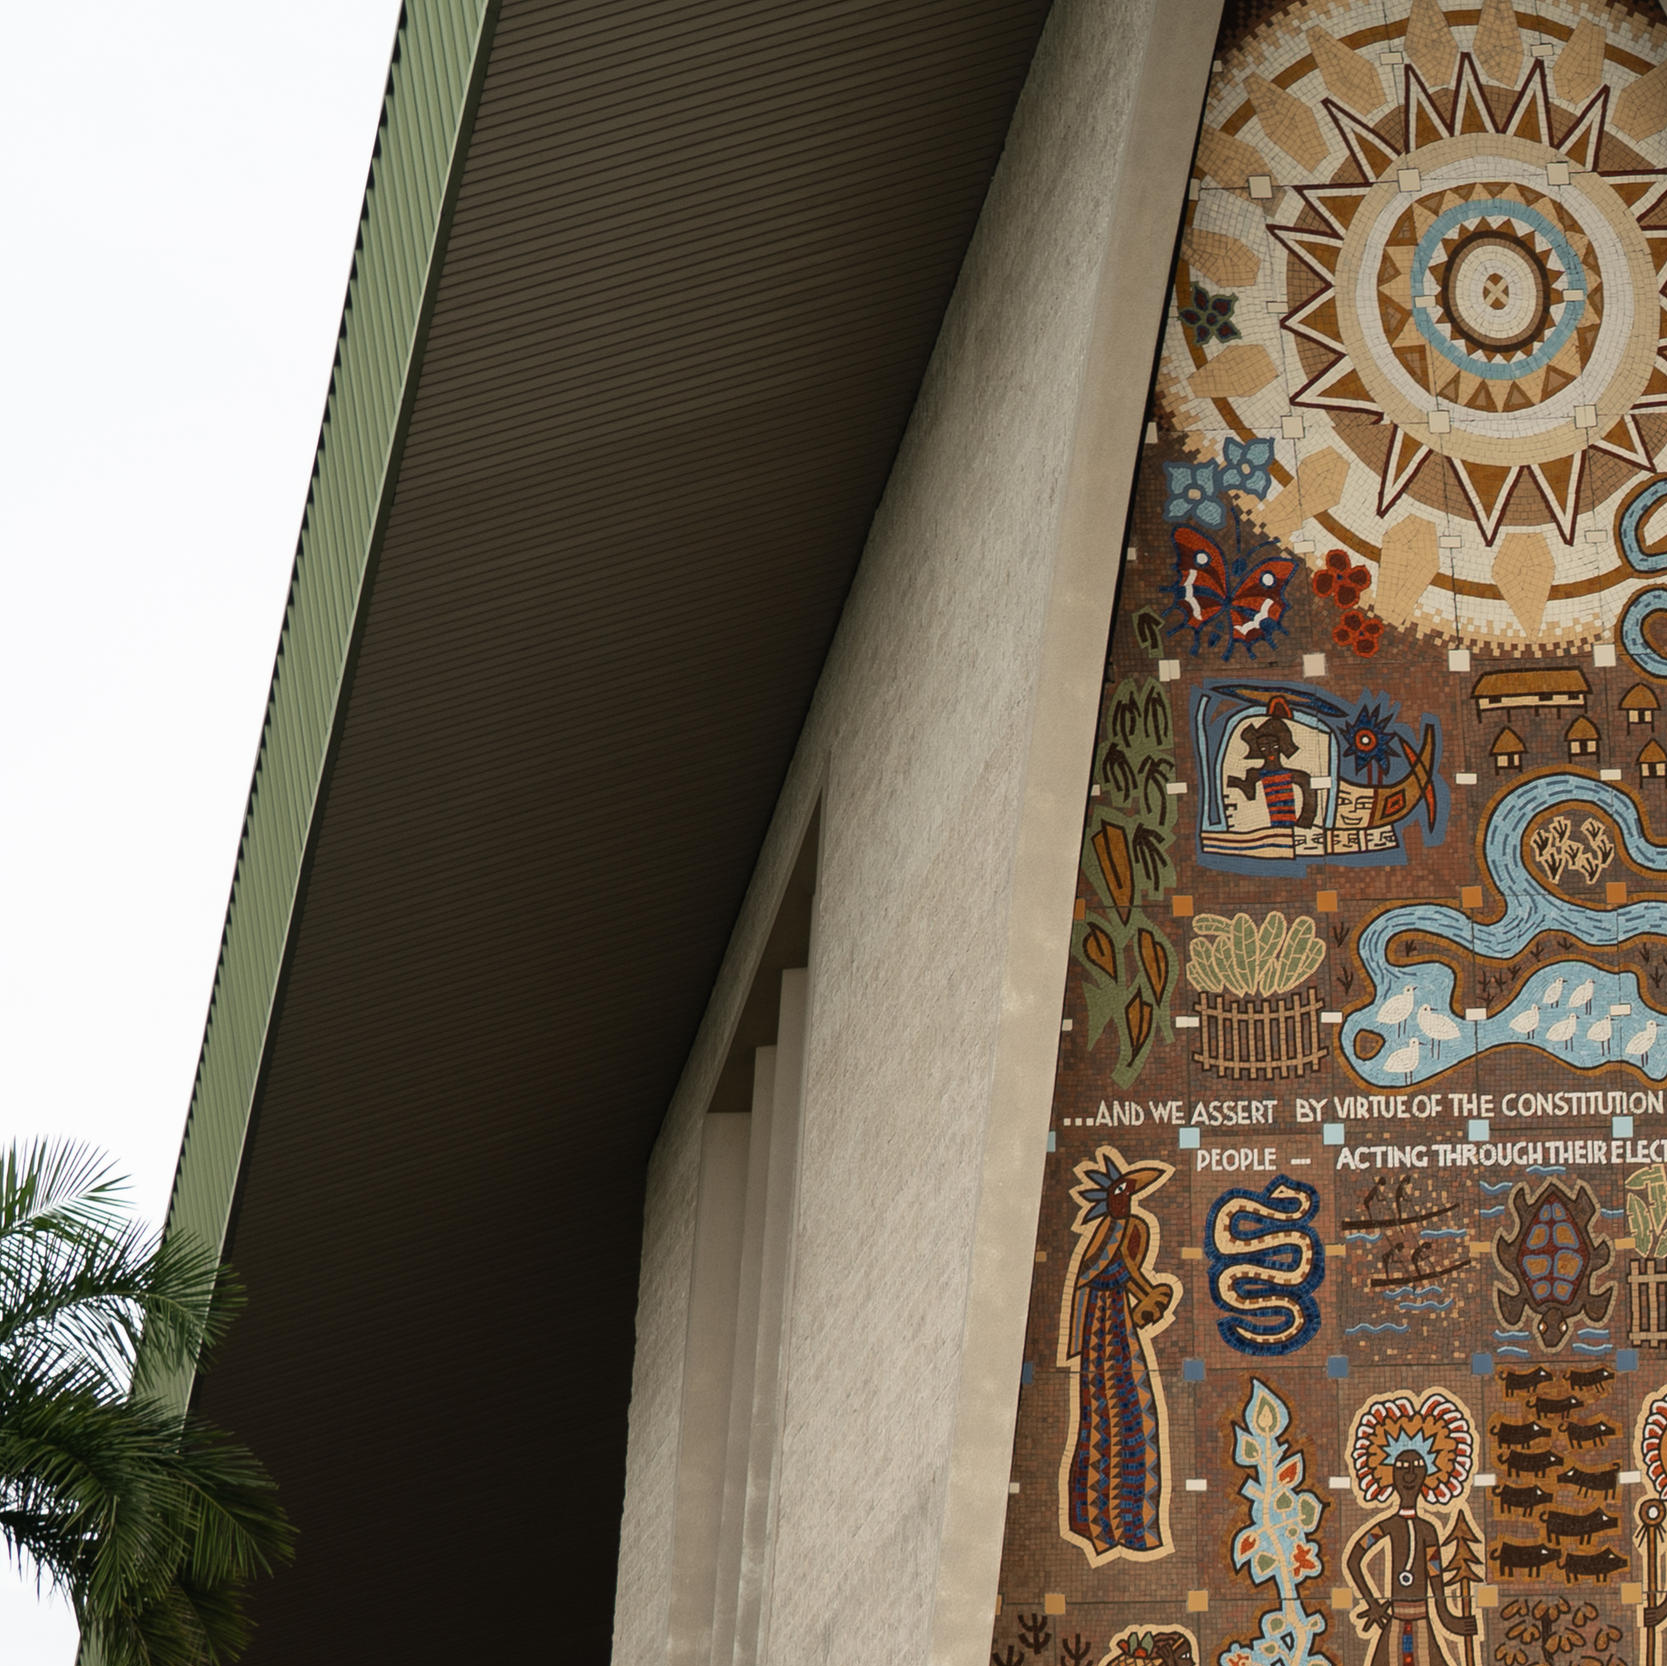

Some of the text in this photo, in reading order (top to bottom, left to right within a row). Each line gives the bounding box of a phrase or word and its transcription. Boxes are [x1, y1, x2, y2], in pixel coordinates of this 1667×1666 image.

[1149, 1101, 1185, 1125] WE
[1190, 1100, 1277, 1126] ASSERT
[1296, 1098, 1328, 1122] BY
[1334, 1095, 1411, 1119] VIRTUE
[1412, 1094, 1442, 1118] OF
[1448, 1093, 1495, 1117] THE
[1502, 1090, 1664, 1116] CONSTITUTION
[1197, 1148, 1276, 1171] PEOPLE
[1336, 1145, 1428, 1170] ACTING
[1431, 1140, 1543, 1167] THROUGH
[1545, 1139, 1608, 1165] THEIR
